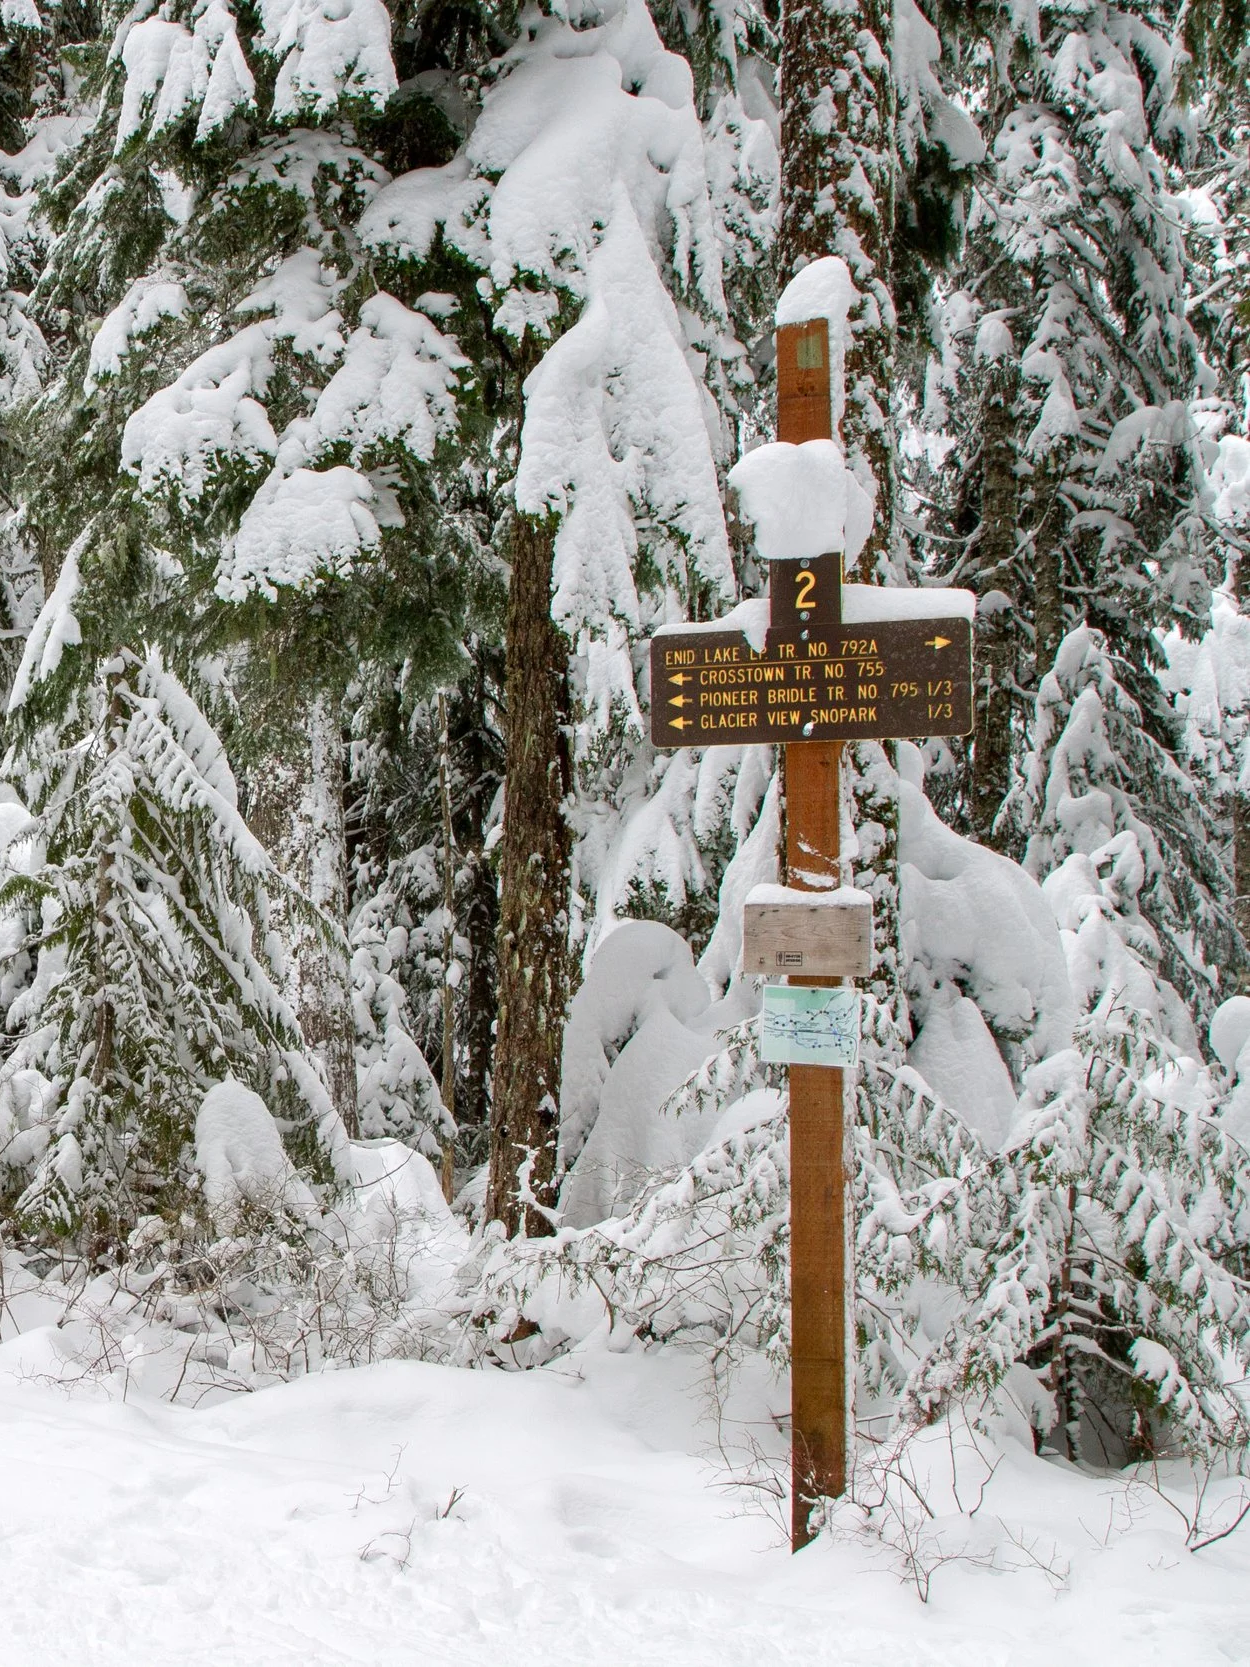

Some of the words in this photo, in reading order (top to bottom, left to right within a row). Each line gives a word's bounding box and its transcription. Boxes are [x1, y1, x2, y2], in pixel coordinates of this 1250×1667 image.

[795, 571, 816, 609] 2
[666, 649, 695, 666] ENID
[705, 647, 740, 663] LAKE
[841, 639, 878, 655] 792A
[700, 667, 784, 685] CROSSTOWN
[858, 661, 885, 677] 755
[700, 690, 758, 707] PIONEER
[768, 688, 817, 704] BRIDLE
[891, 682, 918, 698] 795
[928, 681, 952, 696] 1/3
[701, 712, 757, 729] GLACIER
[768, 710, 800, 725] VIEW
[810, 707, 877, 724] SNOPARK
[928, 704, 953, 720] 1/3
